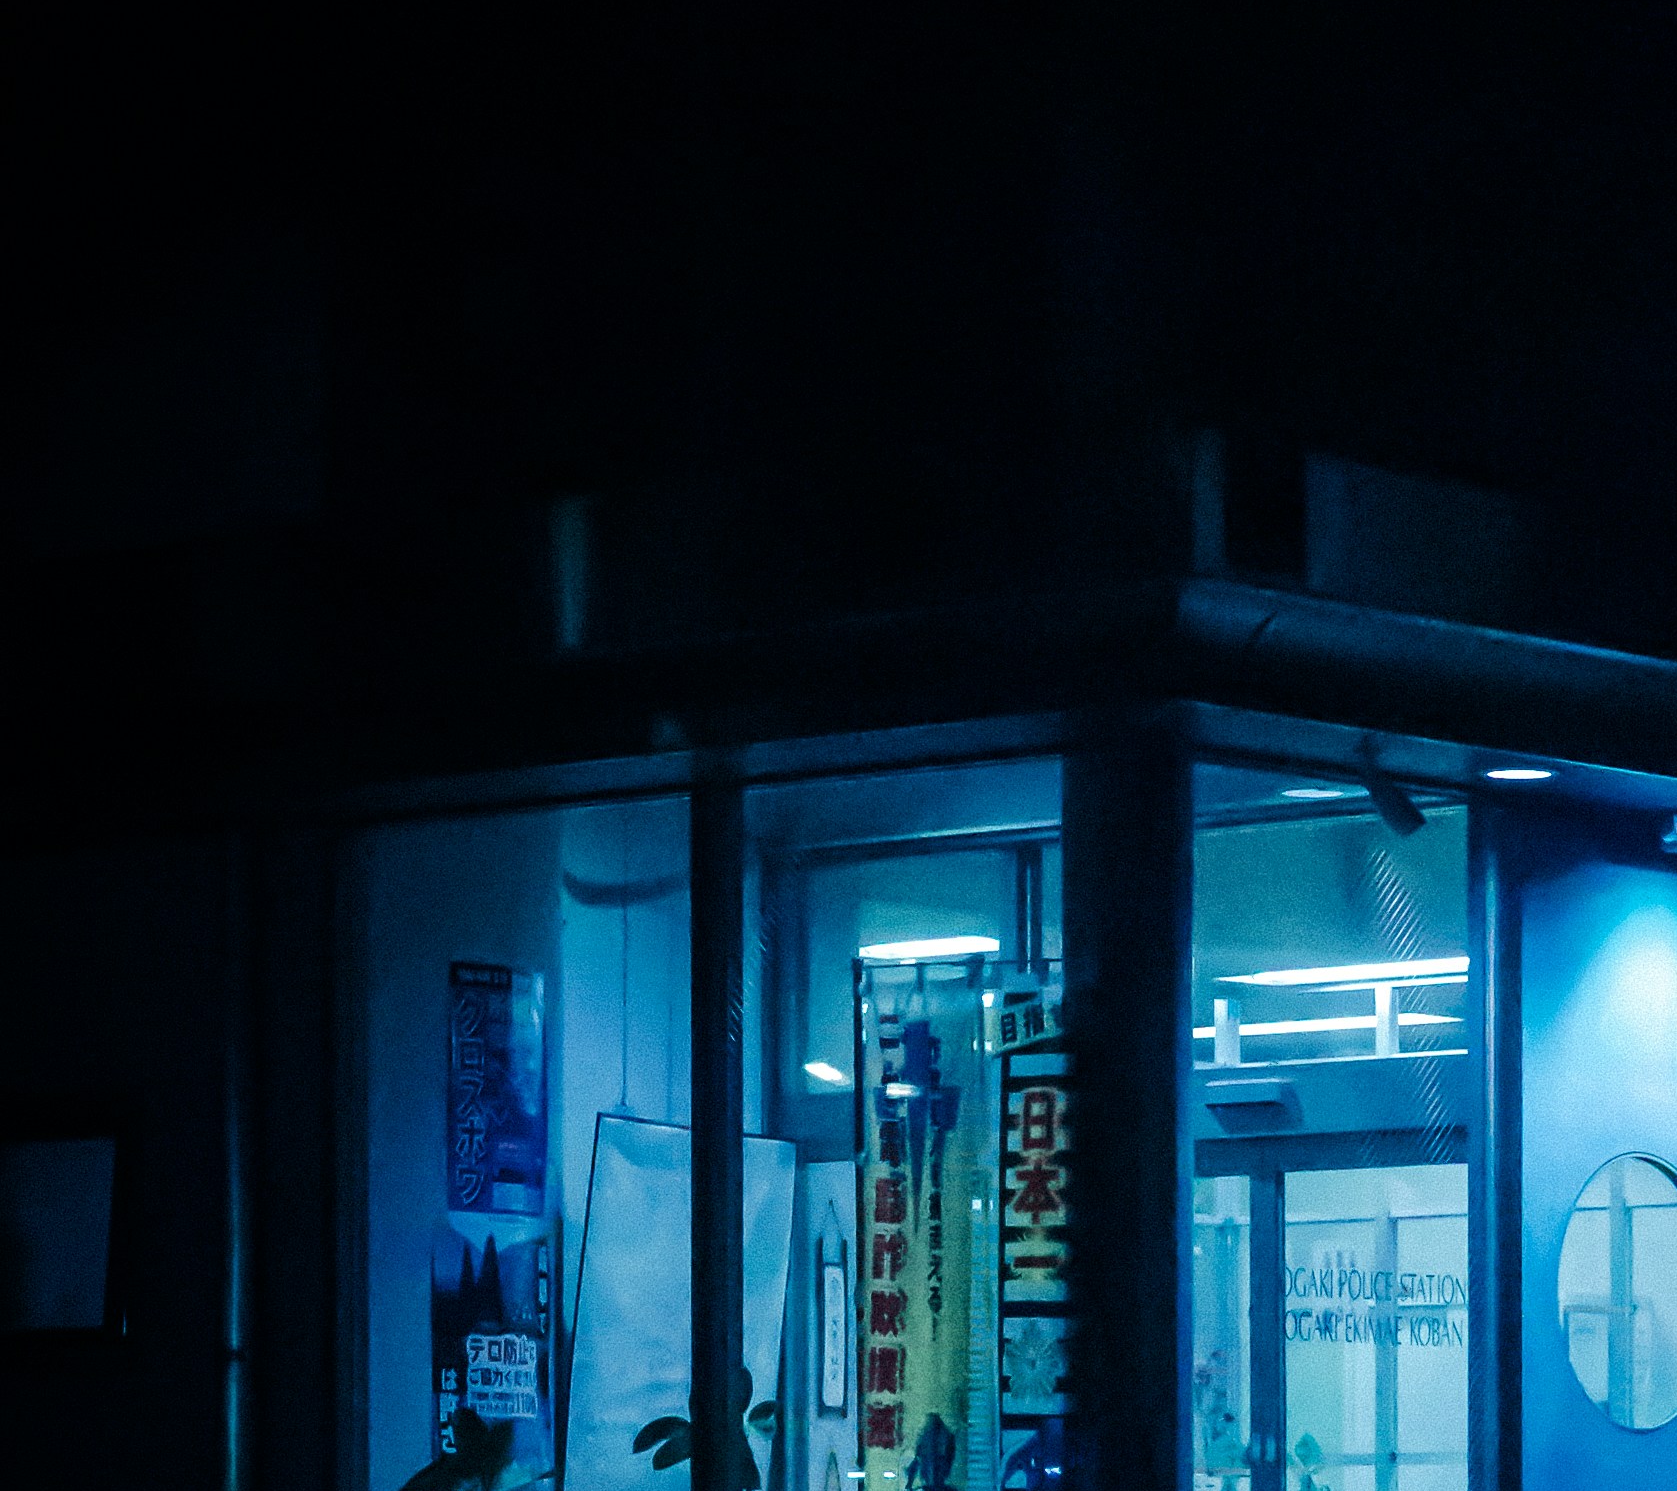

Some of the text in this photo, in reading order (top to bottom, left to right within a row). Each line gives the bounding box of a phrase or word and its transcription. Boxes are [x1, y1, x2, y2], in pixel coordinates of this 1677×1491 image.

[1010, 1087, 1065, 1272] 日本一
[1338, 1269, 1393, 1302] POLICE
[1399, 1273, 1466, 1305] STATION
[1285, 1309, 1463, 1347] OGAKI EKIMAE KOBAN
